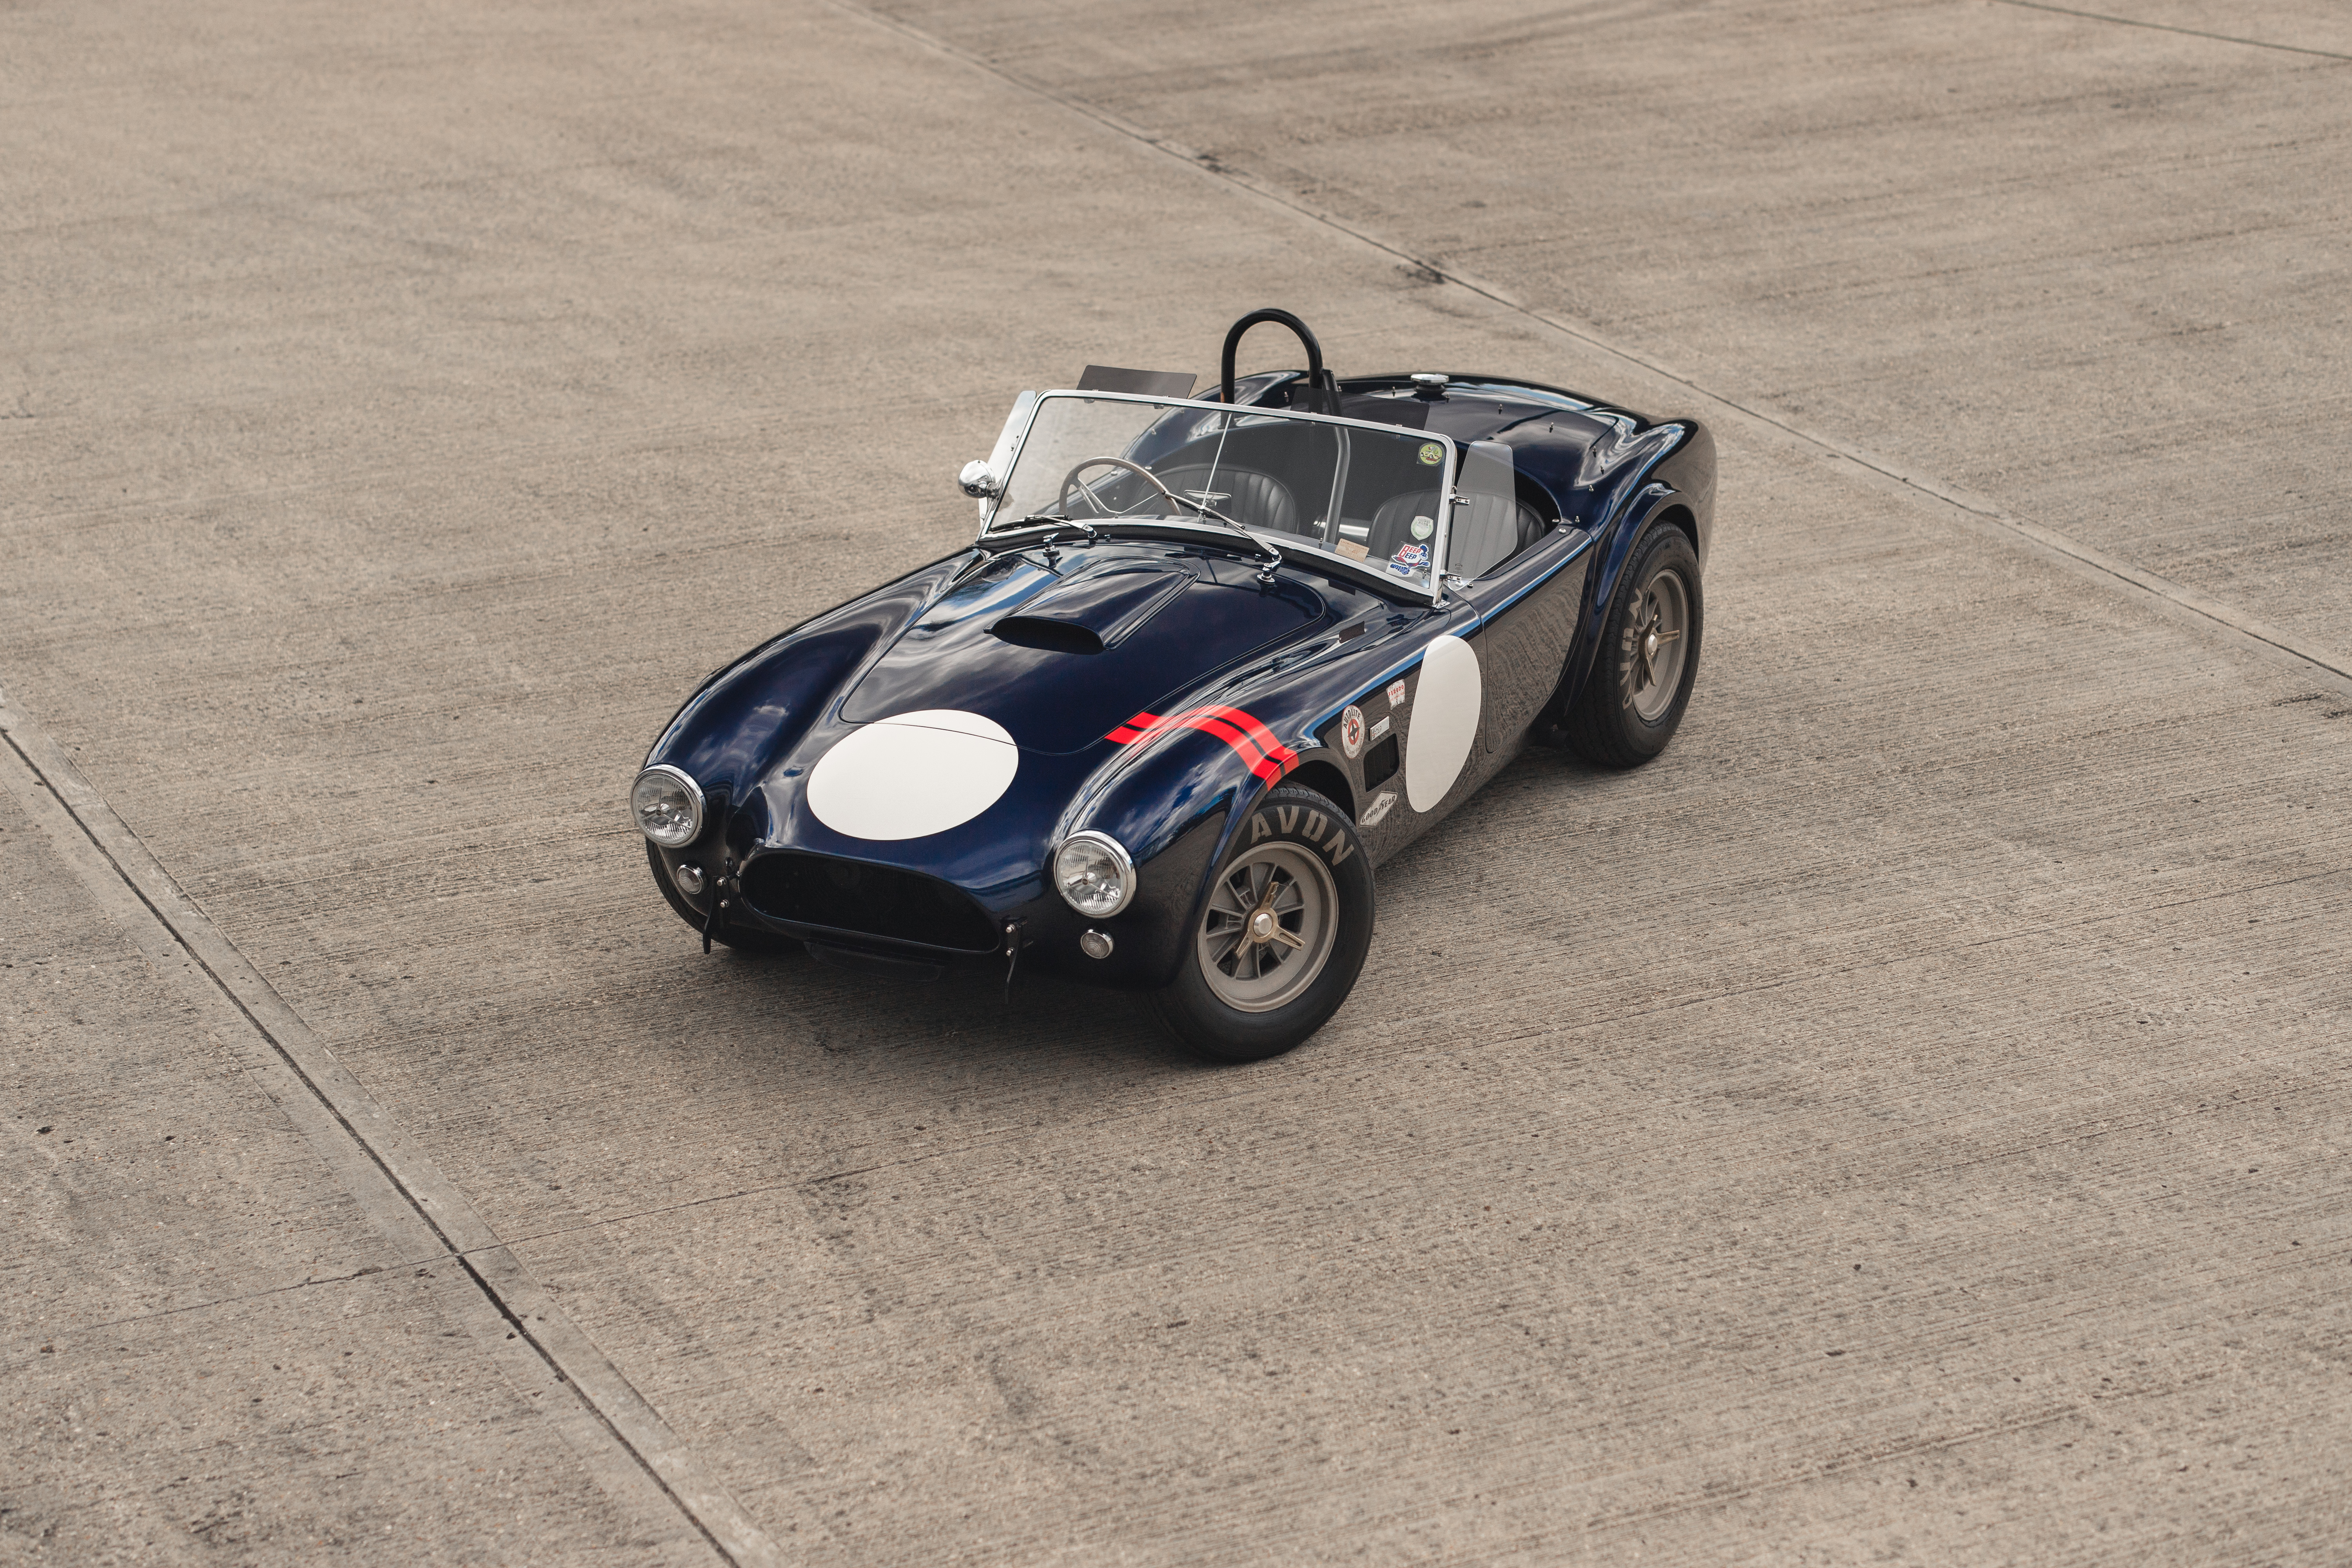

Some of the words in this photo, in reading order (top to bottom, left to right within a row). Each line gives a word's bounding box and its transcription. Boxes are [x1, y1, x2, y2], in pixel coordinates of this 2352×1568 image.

[1398, 545, 1421, 557] BEEP
[1388, 684, 1404, 697] FERODO
[1343, 708, 1360, 729] AUTOLITE
[1346, 745, 1355, 755] SPARK
[1250, 806, 1354, 866] AVON
